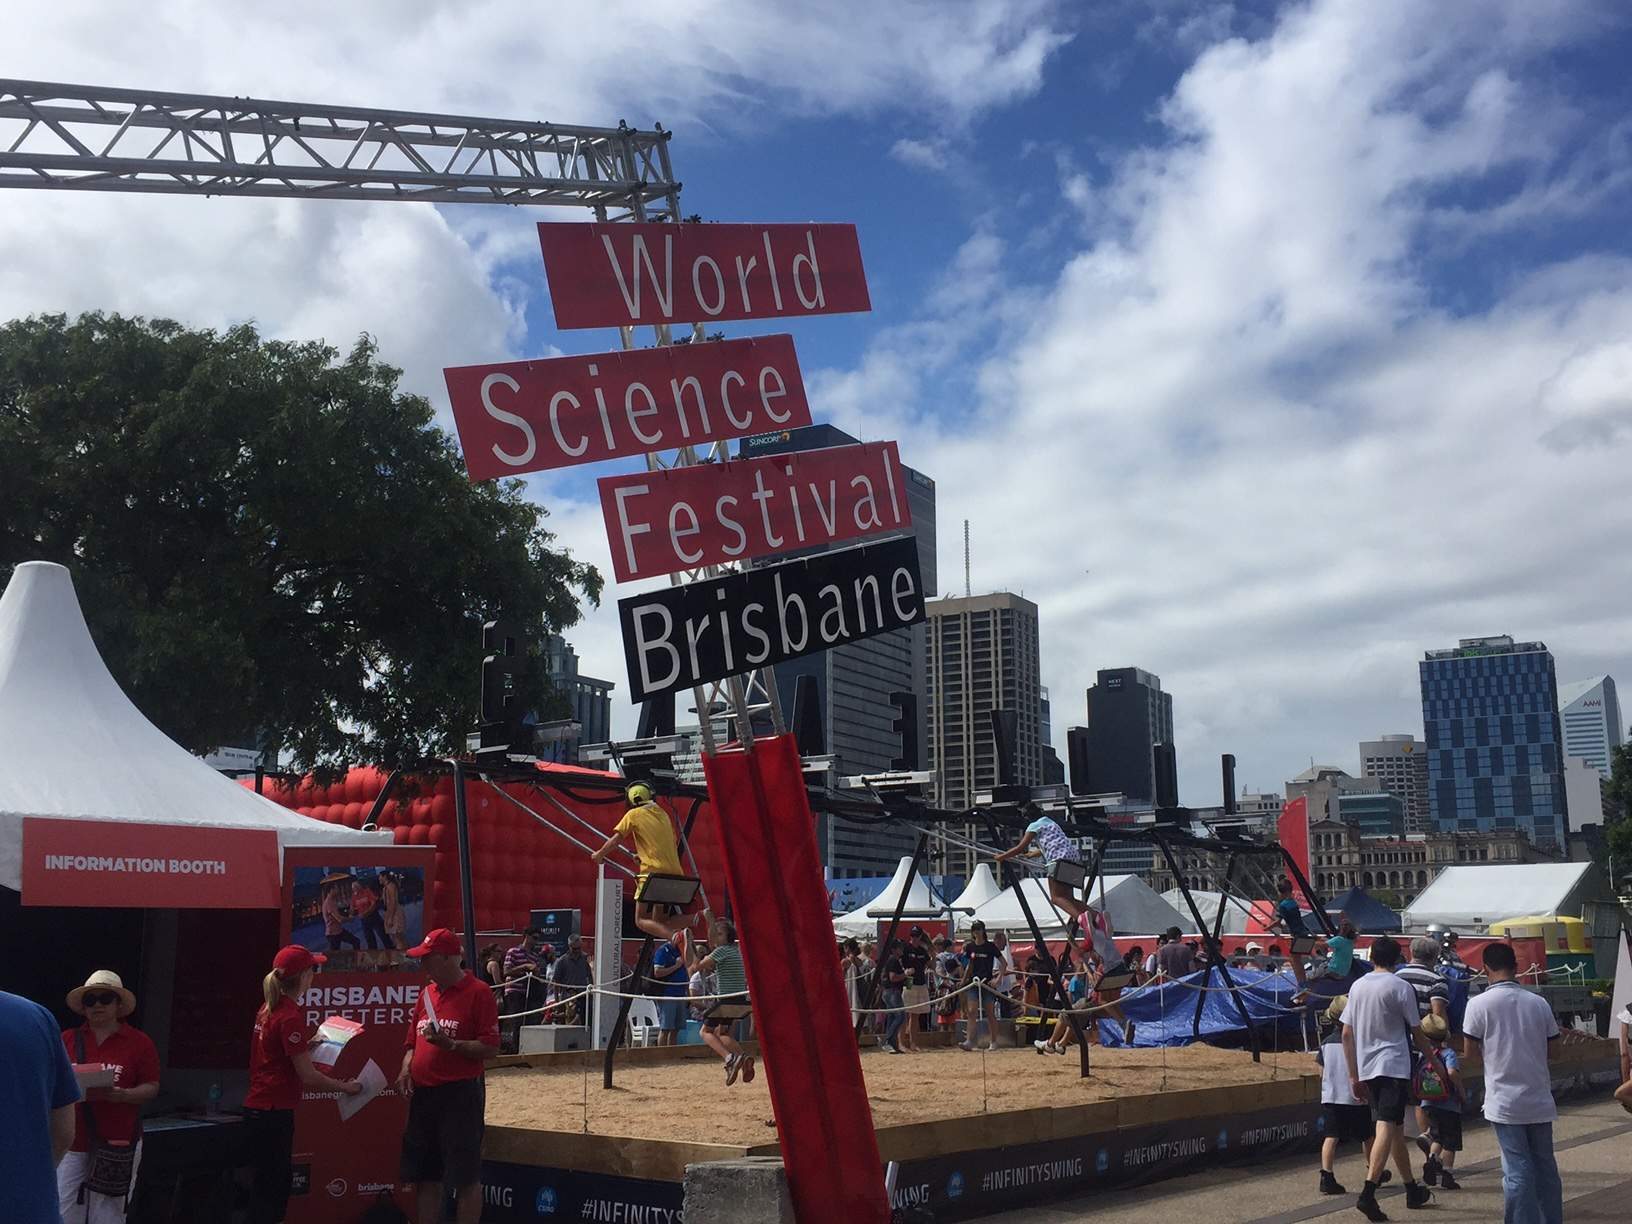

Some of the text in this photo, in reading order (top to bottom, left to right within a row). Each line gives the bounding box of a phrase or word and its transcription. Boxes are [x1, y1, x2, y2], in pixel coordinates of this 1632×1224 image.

[601, 230, 826, 320] World
[480, 363, 792, 467] Science
[614, 448, 901, 574] Festival
[632, 566, 917, 694] Brisbane
[45, 854, 226, 875] INFORMATION BOOTH
[613, 884, 623, 940] FORECOURT
[1123, 1137, 1206, 1167] #INFINITYSWING
[1240, 1121, 1308, 1146] #INFINITYSWING
[982, 1157, 1083, 1191] #INFINITYSWING
[481, 1186, 513, 1208] ING
